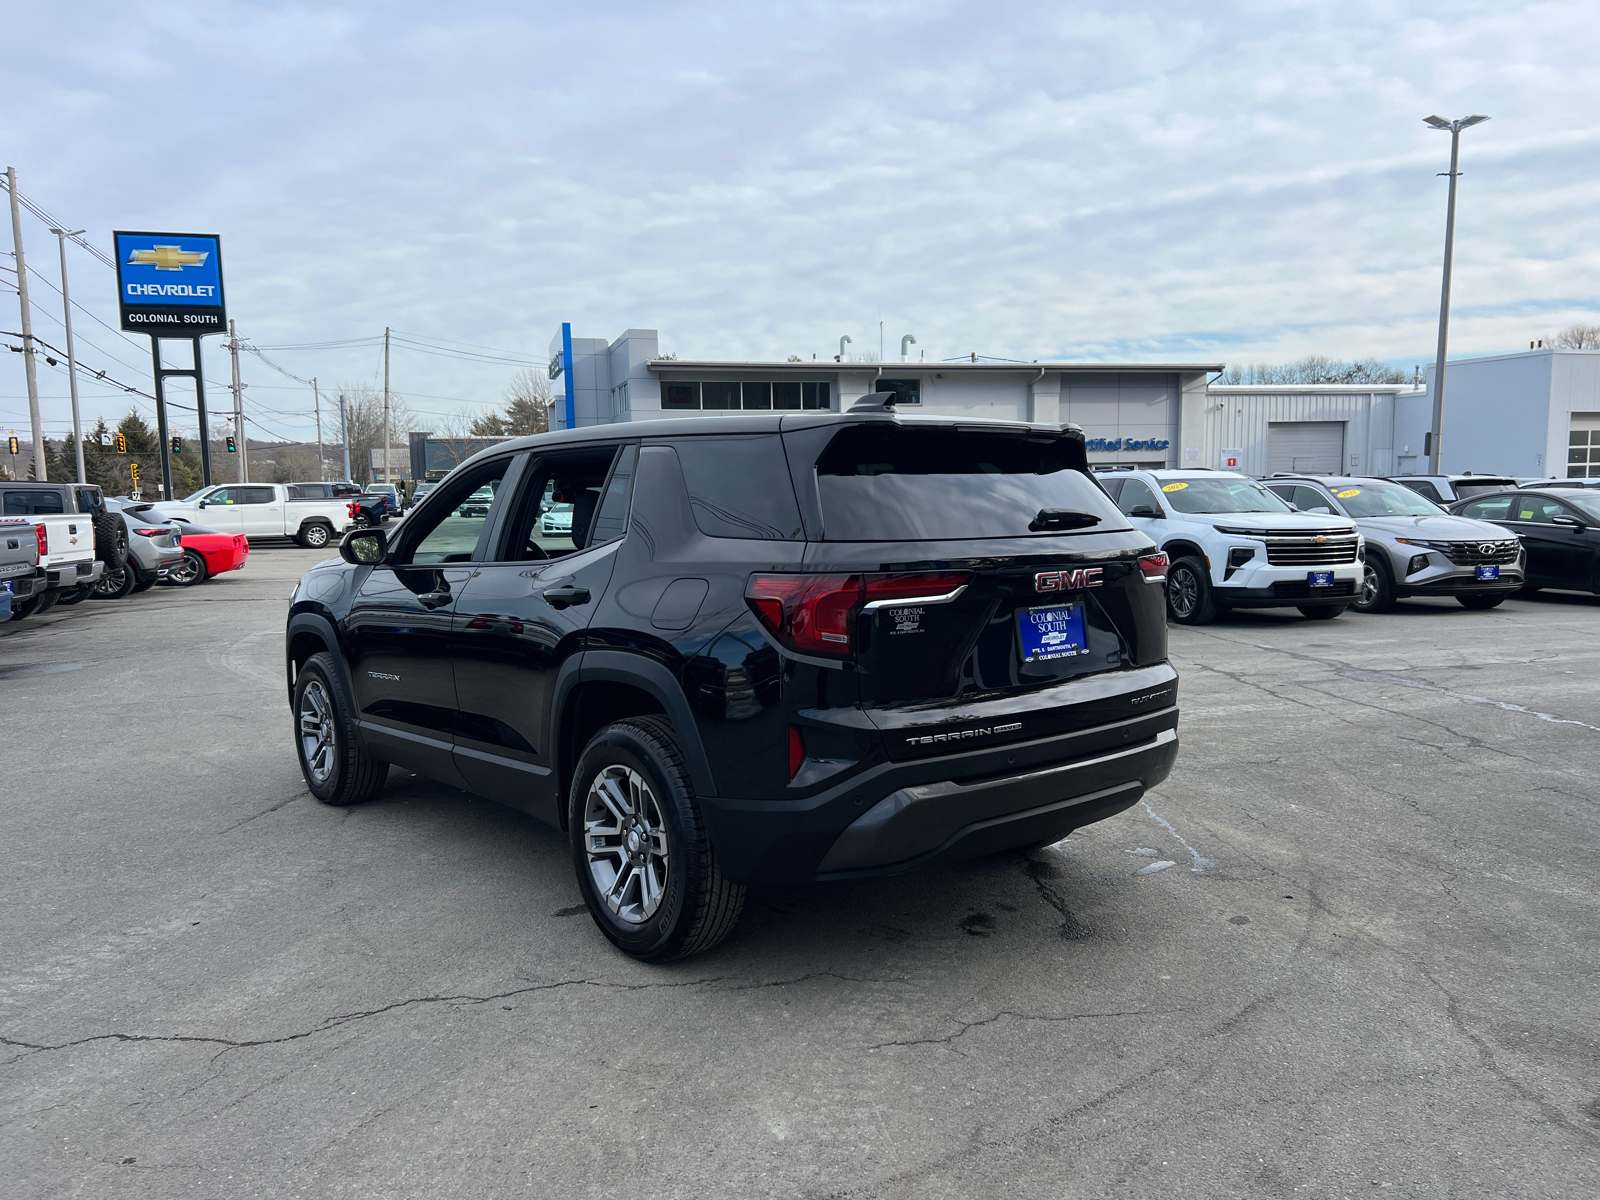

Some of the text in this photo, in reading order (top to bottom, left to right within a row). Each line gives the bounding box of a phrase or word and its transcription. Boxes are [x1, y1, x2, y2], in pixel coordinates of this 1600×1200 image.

[127, 283, 215, 297] CHEVROLET
[128, 313, 218, 324] COLONIAL SOUTH
[1085, 438, 1170, 450] rtified Service
[0, 564, 27, 572] ACOMA
[1035, 567, 1103, 593] GMC
[889, 607, 925, 617] COLONIAL
[1030, 610, 1071, 624] COLONIAL
[894, 614, 920, 623] SOUTH
[1038, 621, 1067, 633] SOUTH
[1043, 634, 1065, 642] CHEVROLET
[1038, 650, 1077, 661] COLONIAL SOUTH
[906, 727, 992, 746] TERRAIN
[660, 877, 678, 931] MICHELIN
